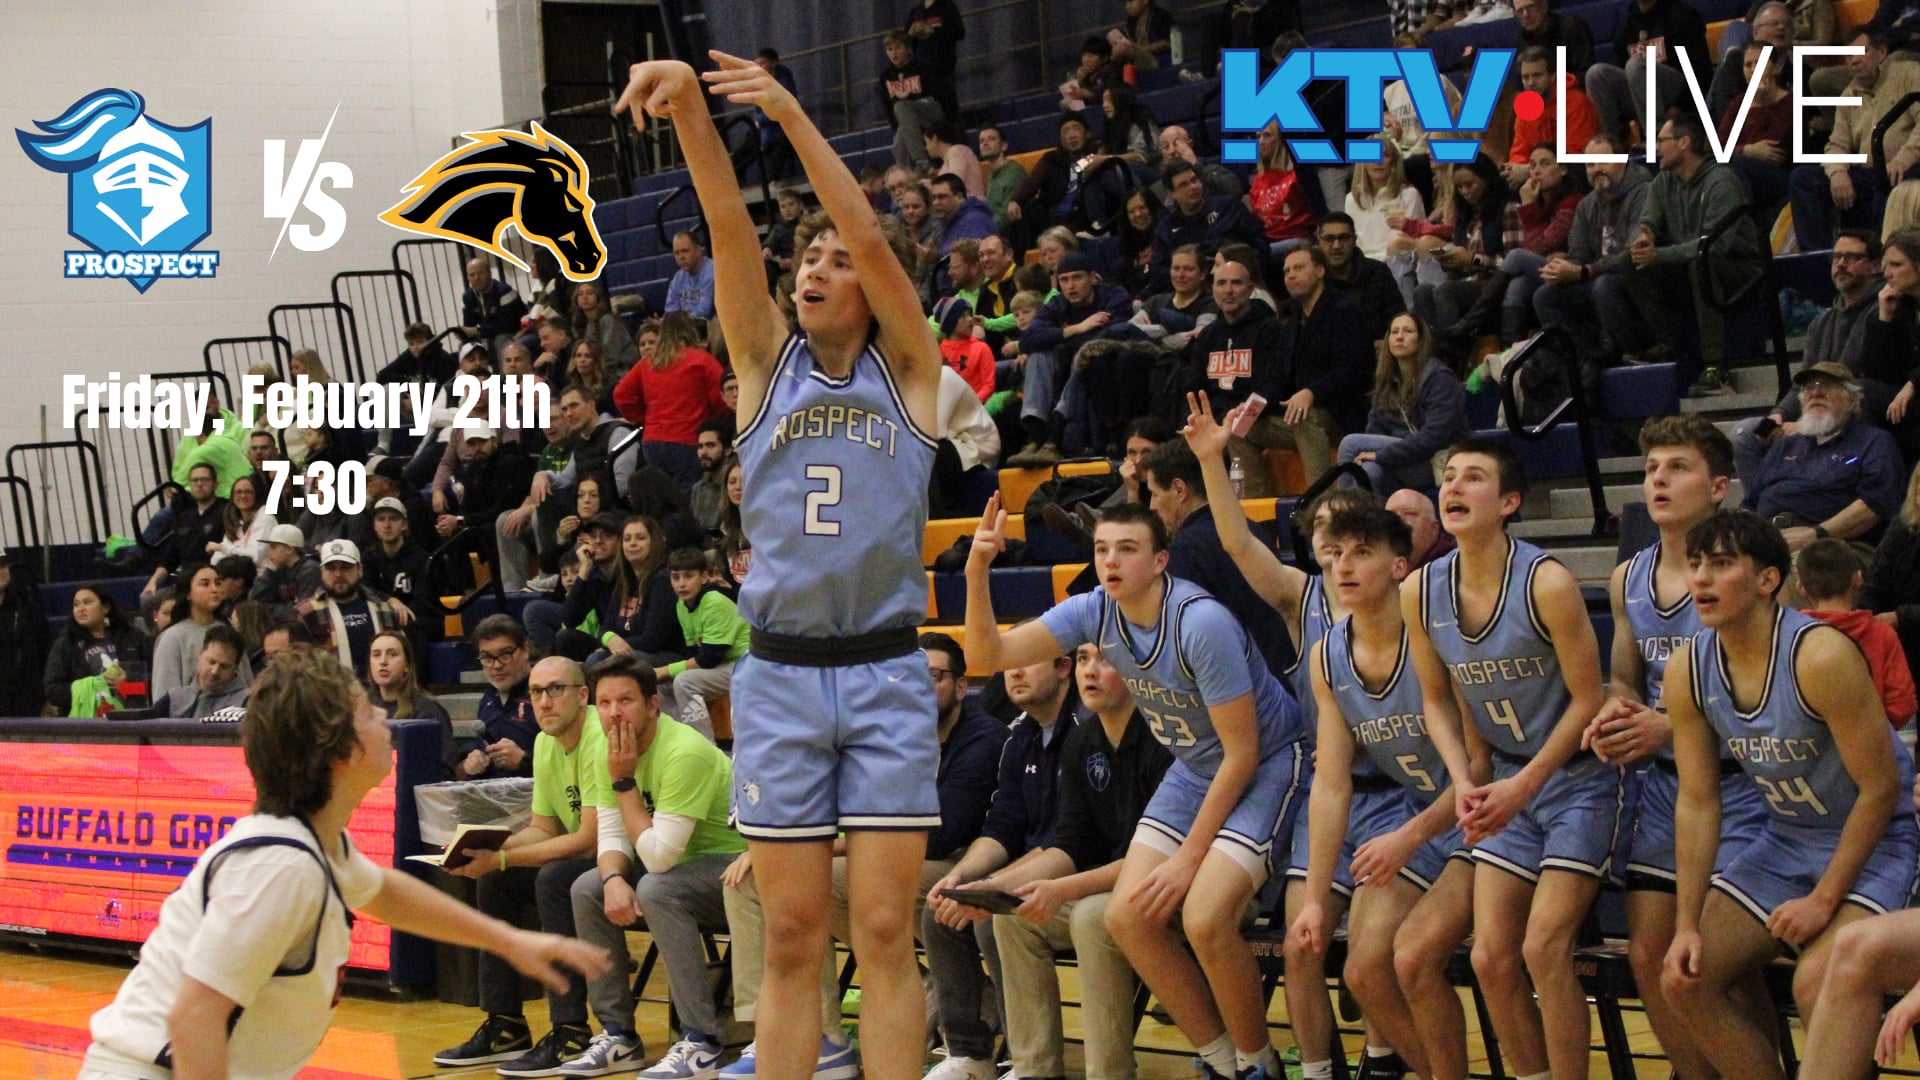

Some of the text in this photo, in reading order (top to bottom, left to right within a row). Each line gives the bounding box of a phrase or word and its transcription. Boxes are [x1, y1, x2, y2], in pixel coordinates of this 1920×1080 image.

[804, 464, 842, 536] 2
[1143, 706, 1197, 747] 23
[1484, 699, 1526, 742] 4
[1394, 754, 1437, 792] 5
[1754, 775, 1829, 816] 24
[17, 805, 154, 846] BUFFALO
